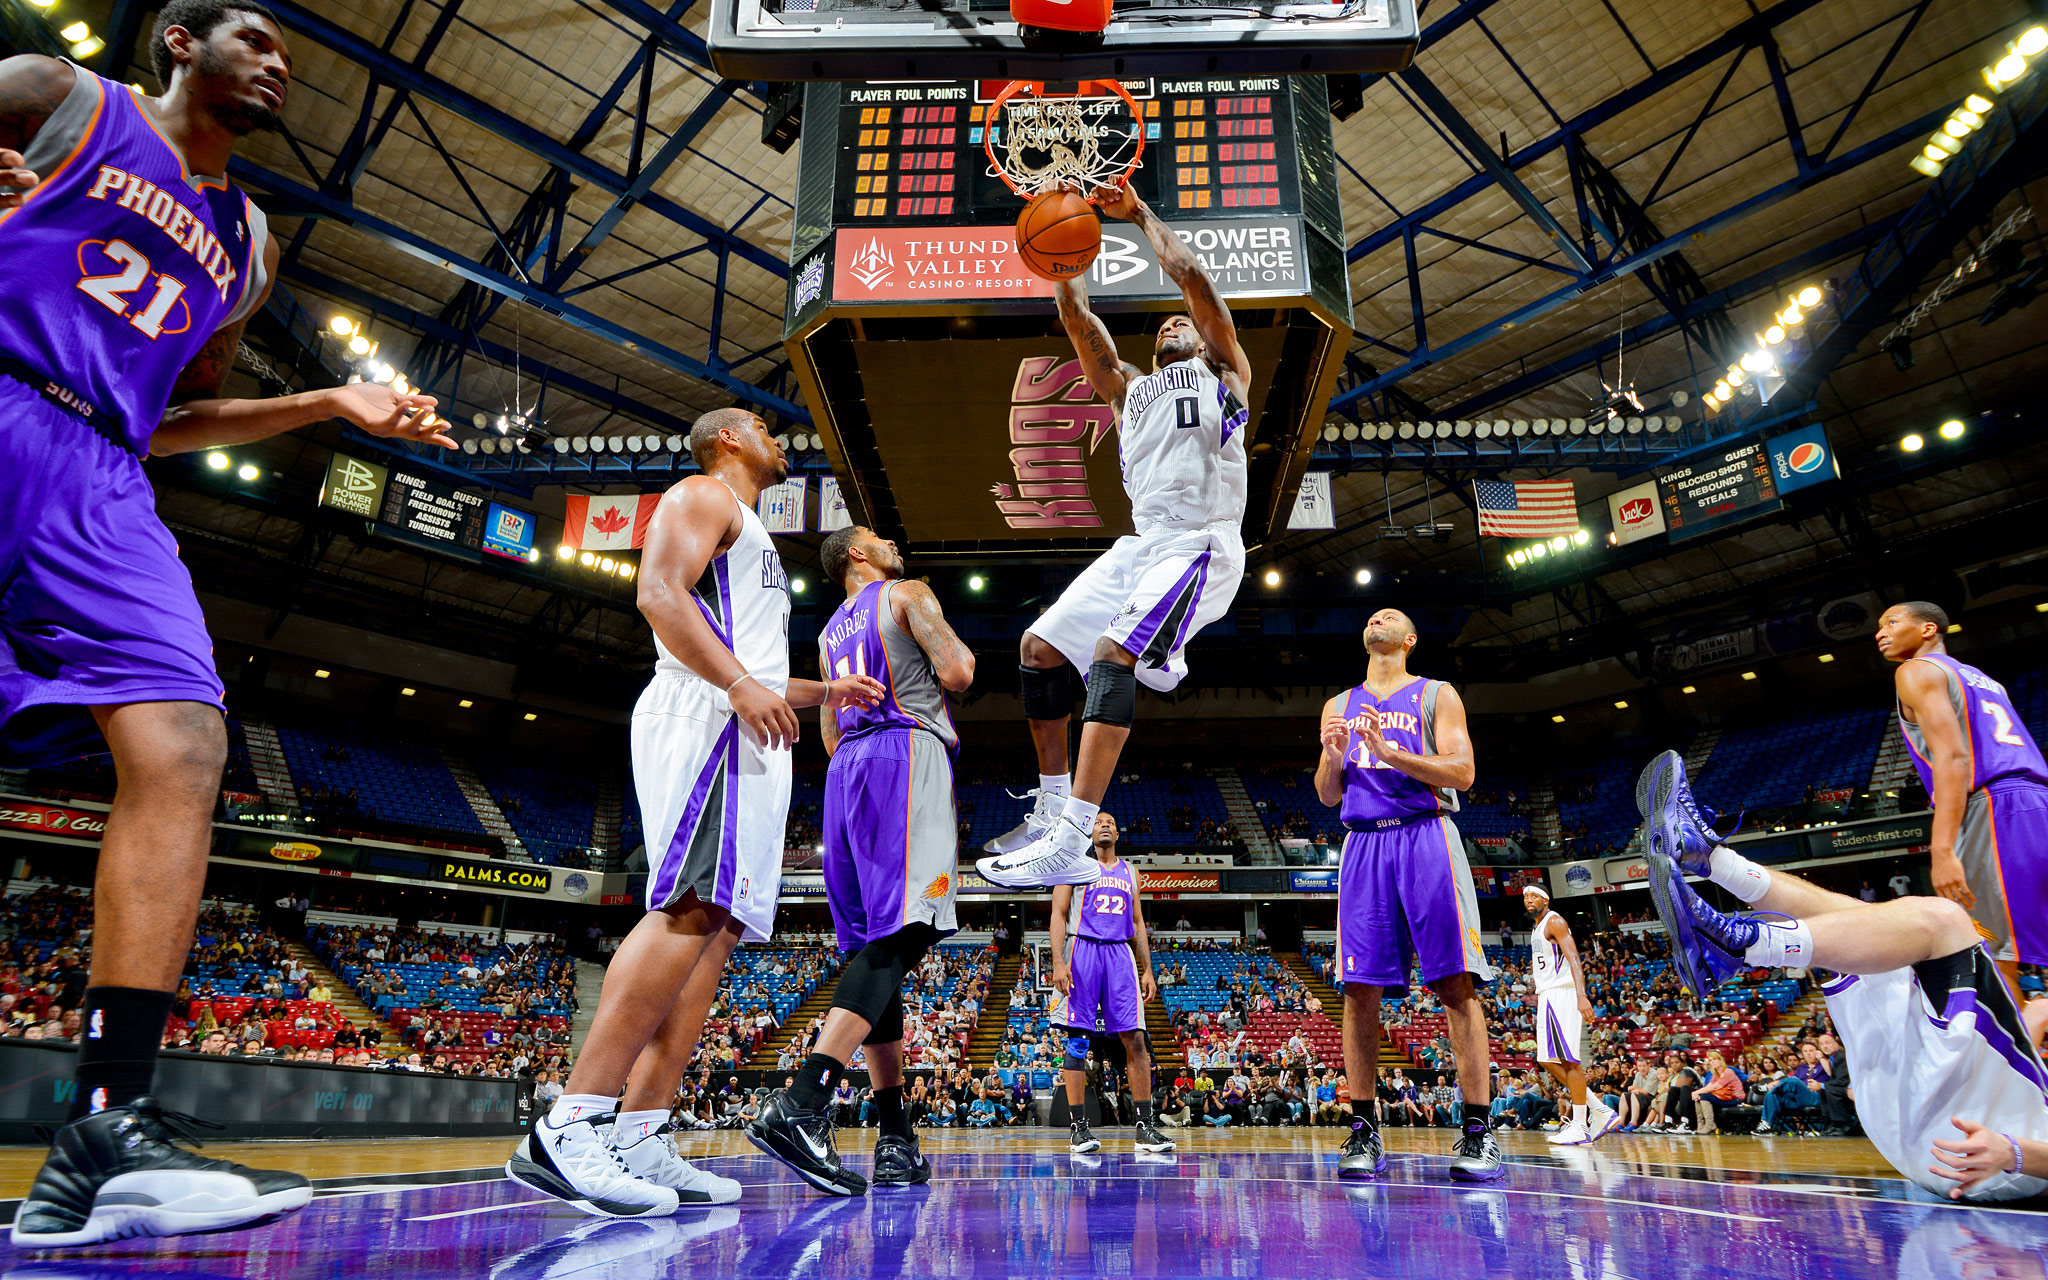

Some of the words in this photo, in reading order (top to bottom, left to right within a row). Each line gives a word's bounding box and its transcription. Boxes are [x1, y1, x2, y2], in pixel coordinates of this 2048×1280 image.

[1118, 81, 1146, 90] ERIOD
[1162, 81, 1203, 94] PLAYER
[1207, 80, 1235, 92] FOUL
[1240, 79, 1280, 91] POINTS
[850, 89, 891, 102] PLAYER
[895, 89, 922, 101] FOUL
[927, 88, 967, 100] POINTS
[1088, 103, 1121, 115] LEFT
[86, 164, 237, 304] PHOENIX
[1172, 227, 1292, 250] POWER
[904, 259, 1006, 277] VALLEY
[1196, 251, 1294, 271] ALANCE
[908, 280, 965, 289] CASINO
[976, 278, 1033, 288] RESORT
[1207, 270, 1295, 283] VILION
[76, 238, 187, 341] 21
[45, 381, 95, 418] SUNS
[1128, 366, 1200, 430] SACRAMENTO
[1175, 396, 1201, 430] 0
[1725, 443, 1761, 463] GUEST
[1774, 451, 1791, 479] pepsi
[395, 472, 426, 489] KINGS
[1660, 468, 1692, 484] KINGS
[1678, 469, 1718, 490] BLOCKED
[1718, 461, 1748, 477] SHOTS
[1688, 474, 1744, 498] REBOUNDS
[332, 495, 371, 511] BALANCE
[333, 487, 372, 504] POWER
[410, 489, 434, 502] FIELD
[452, 490, 483, 507] GUEST
[1698, 488, 1739, 508] STEALS
[330, 501, 370, 516] PAVILION
[771, 502, 784, 515] 14
[1621, 501, 1652, 523] Jack
[415, 511, 451, 528] ASSISTS
[408, 519, 456, 540] TURNOVERS
[826, 608, 870, 652] MORRIS
[1346, 712, 1418, 736] PHENIX
[1980, 699, 2025, 746] 2
[0, 809, 42, 824] zza
[1377, 818, 1401, 828] SUNS
[275, 842, 293, 851] 1140
[1832, 828, 1923, 848] studentsfirst.org
[329, 869, 341, 877] 118
[444, 864, 547, 888] PALMS.COM
[1139, 874, 1218, 889] Budweiser
[1090, 876, 1132, 895] PHOENIX
[610, 895, 624, 905] 119
[1096, 895, 1124, 915] 22
[1537, 955, 1546, 970] 5
